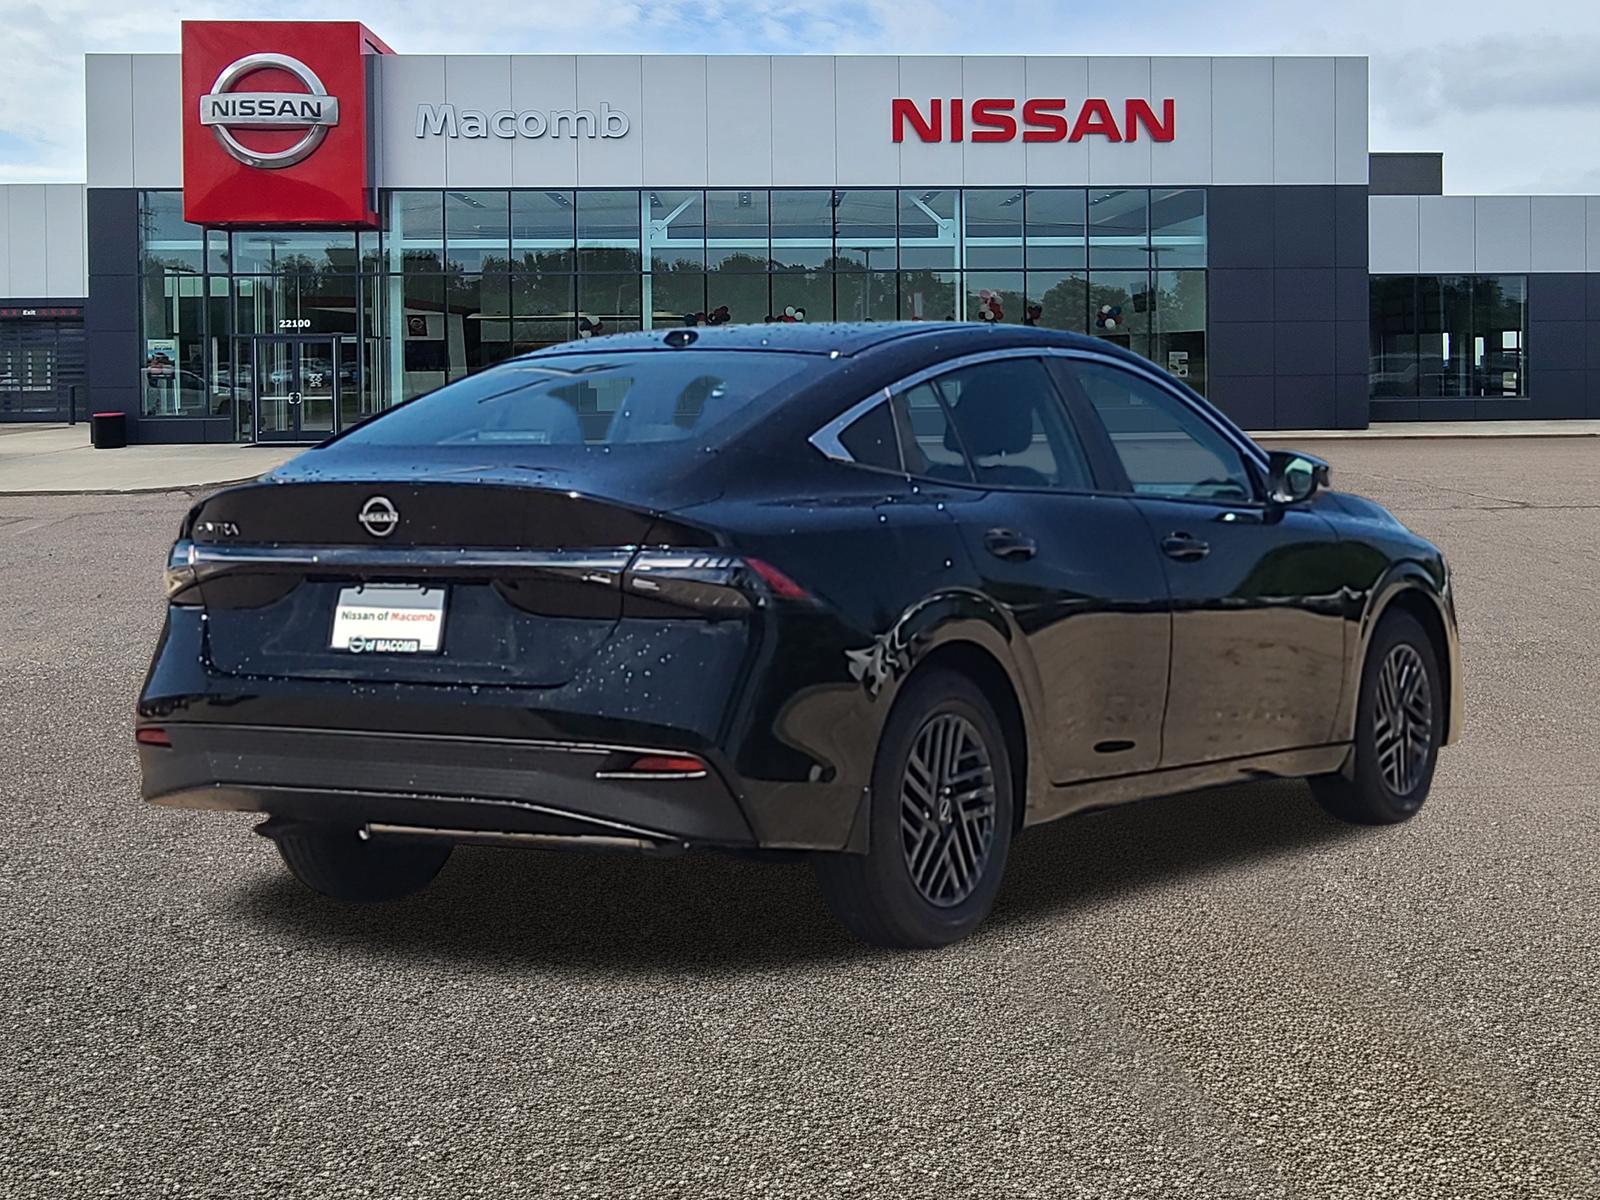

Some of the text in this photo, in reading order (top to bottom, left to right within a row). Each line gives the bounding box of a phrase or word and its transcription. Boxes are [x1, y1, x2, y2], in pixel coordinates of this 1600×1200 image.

[211, 100, 322, 118] NISSAN
[415, 102, 630, 138] Macomb
[891, 98, 1175, 142] NISSAN
[279, 319, 311, 328] 22100
[341, 611, 436, 622] Nissan of Macomb
[365, 640, 418, 652] of MACOMB
